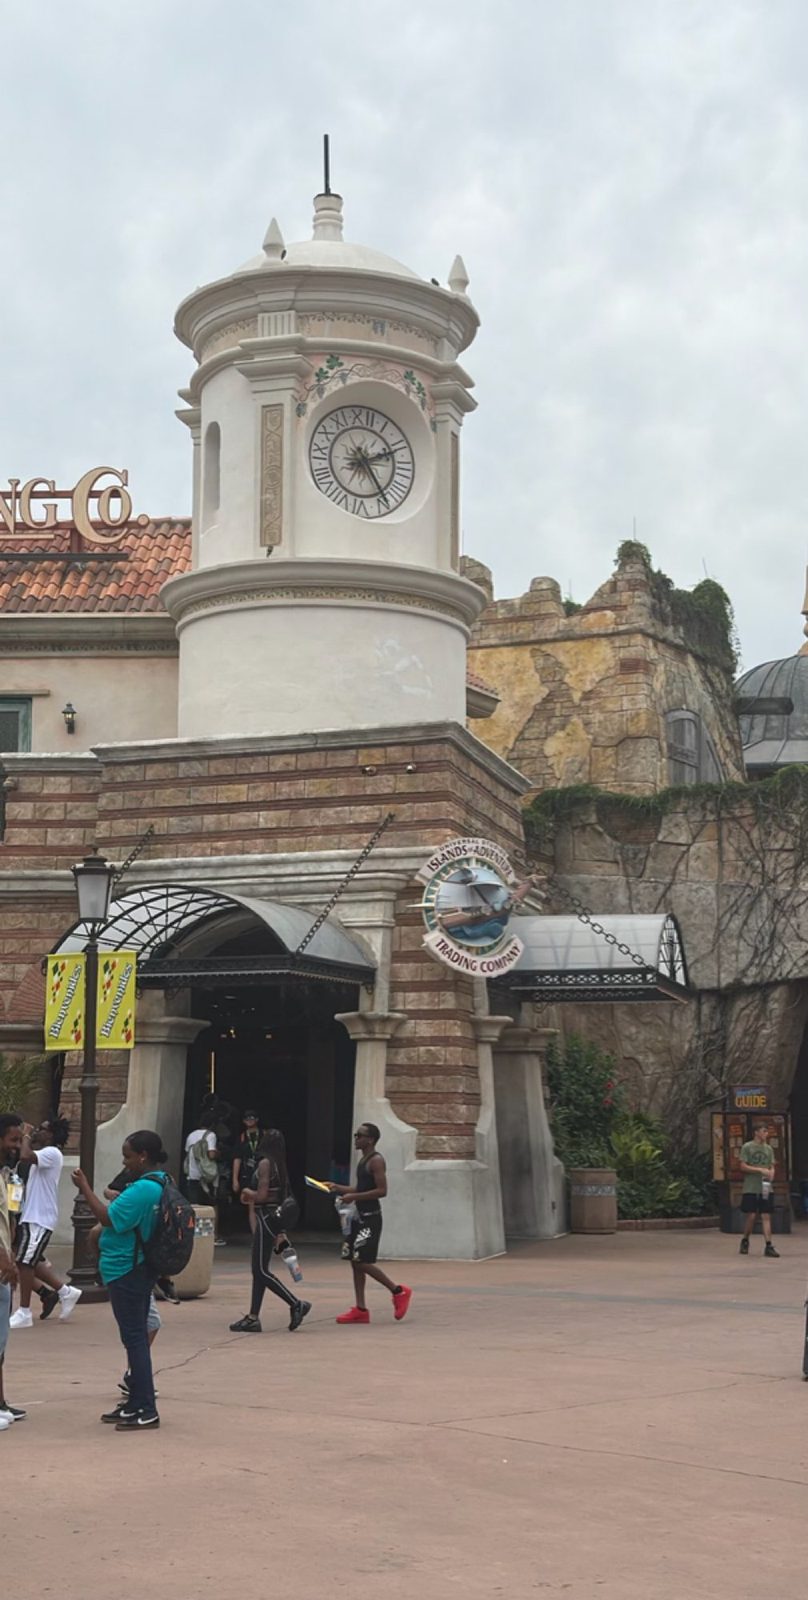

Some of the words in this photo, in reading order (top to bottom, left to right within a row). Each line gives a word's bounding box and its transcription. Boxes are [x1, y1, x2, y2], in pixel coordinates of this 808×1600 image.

[329, 411, 348, 430] XI
[352, 409, 375, 427] XII
[317, 424, 335, 441] X
[312, 443, 329, 460] IX
[396, 461, 411, 479] III
[427, 845, 468, 872] ISLANDS
[436, 939, 478, 971] TRADING
[480, 945, 521, 973] COMPANY
[735, 1095, 767, 1108] GUIDE
